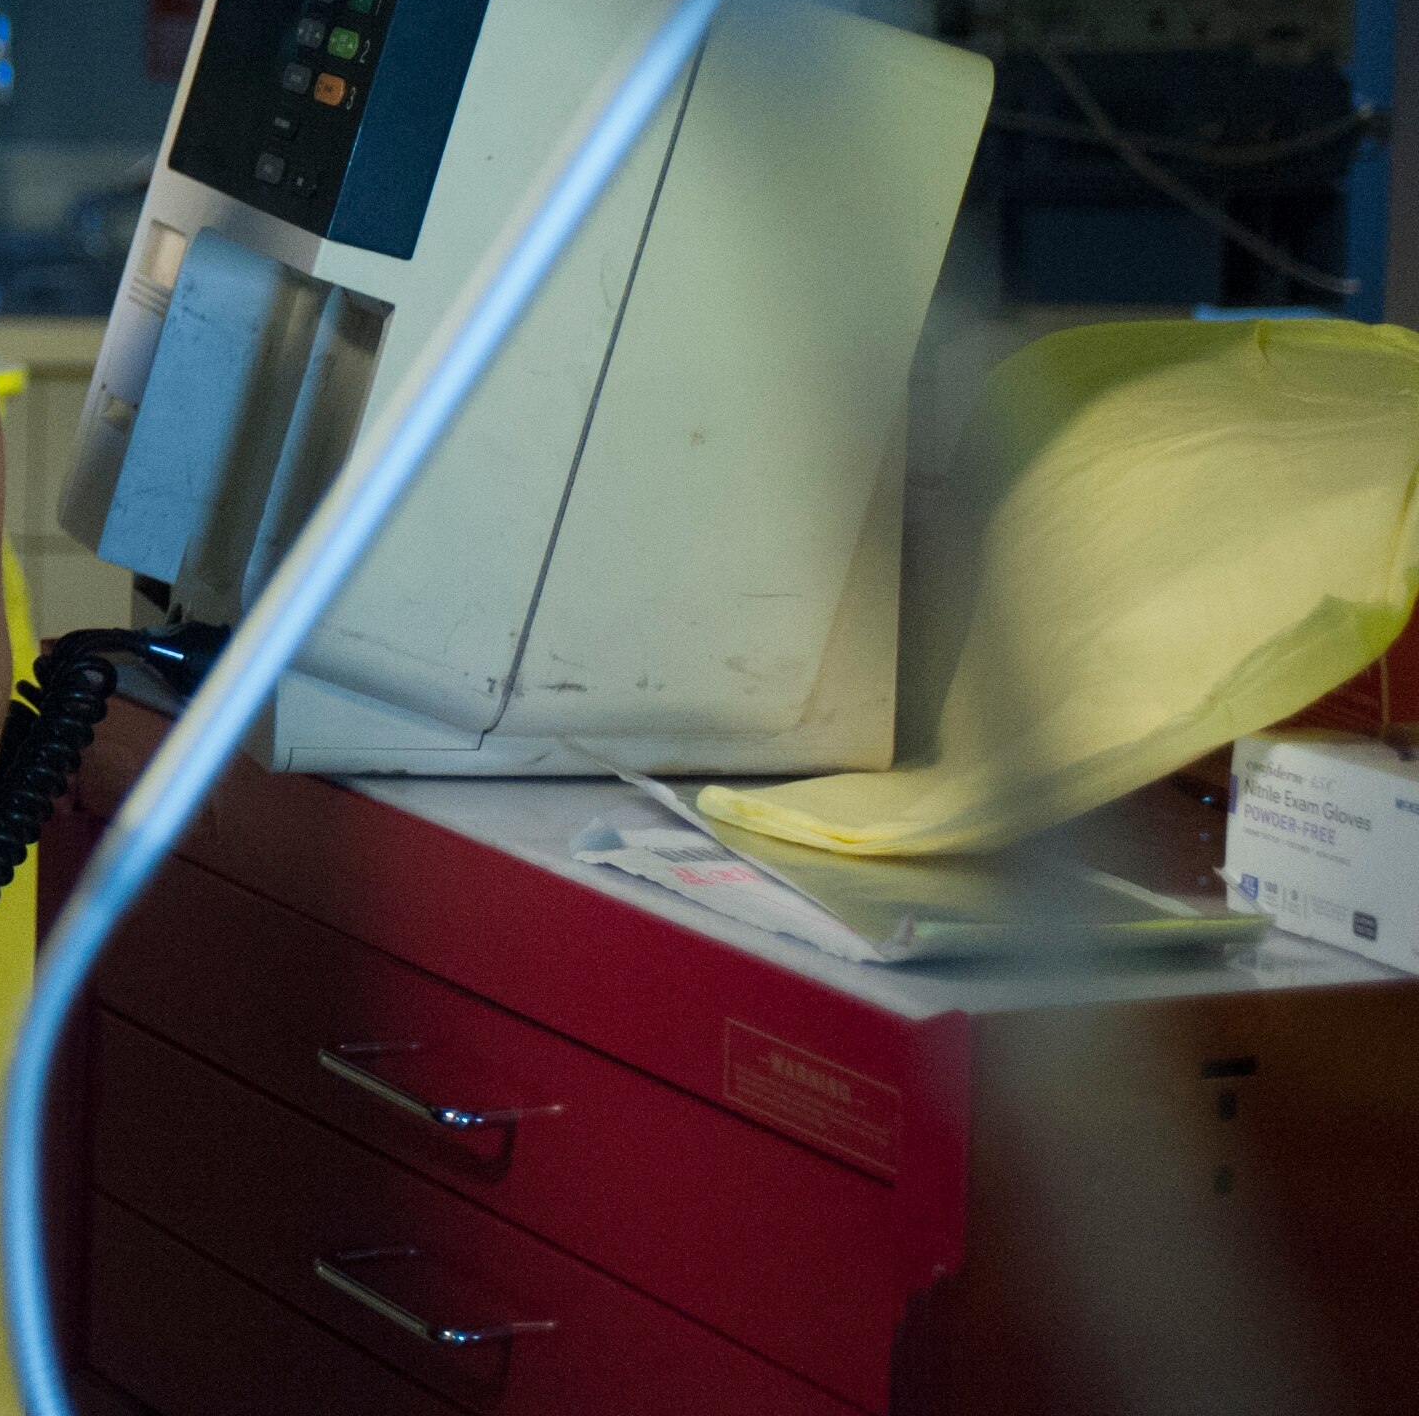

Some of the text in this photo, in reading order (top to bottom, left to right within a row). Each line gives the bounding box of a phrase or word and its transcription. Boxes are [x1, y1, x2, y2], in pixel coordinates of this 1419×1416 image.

[360, 39, 371, 63] 2
[346, 86, 356, 110] 3
[1244, 778, 1281, 803] Nitrile
[1284, 790, 1319, 814] Exam
[1322, 801, 1372, 831] Gloves
[1244, 803, 1337, 846] POWDER-FREE
